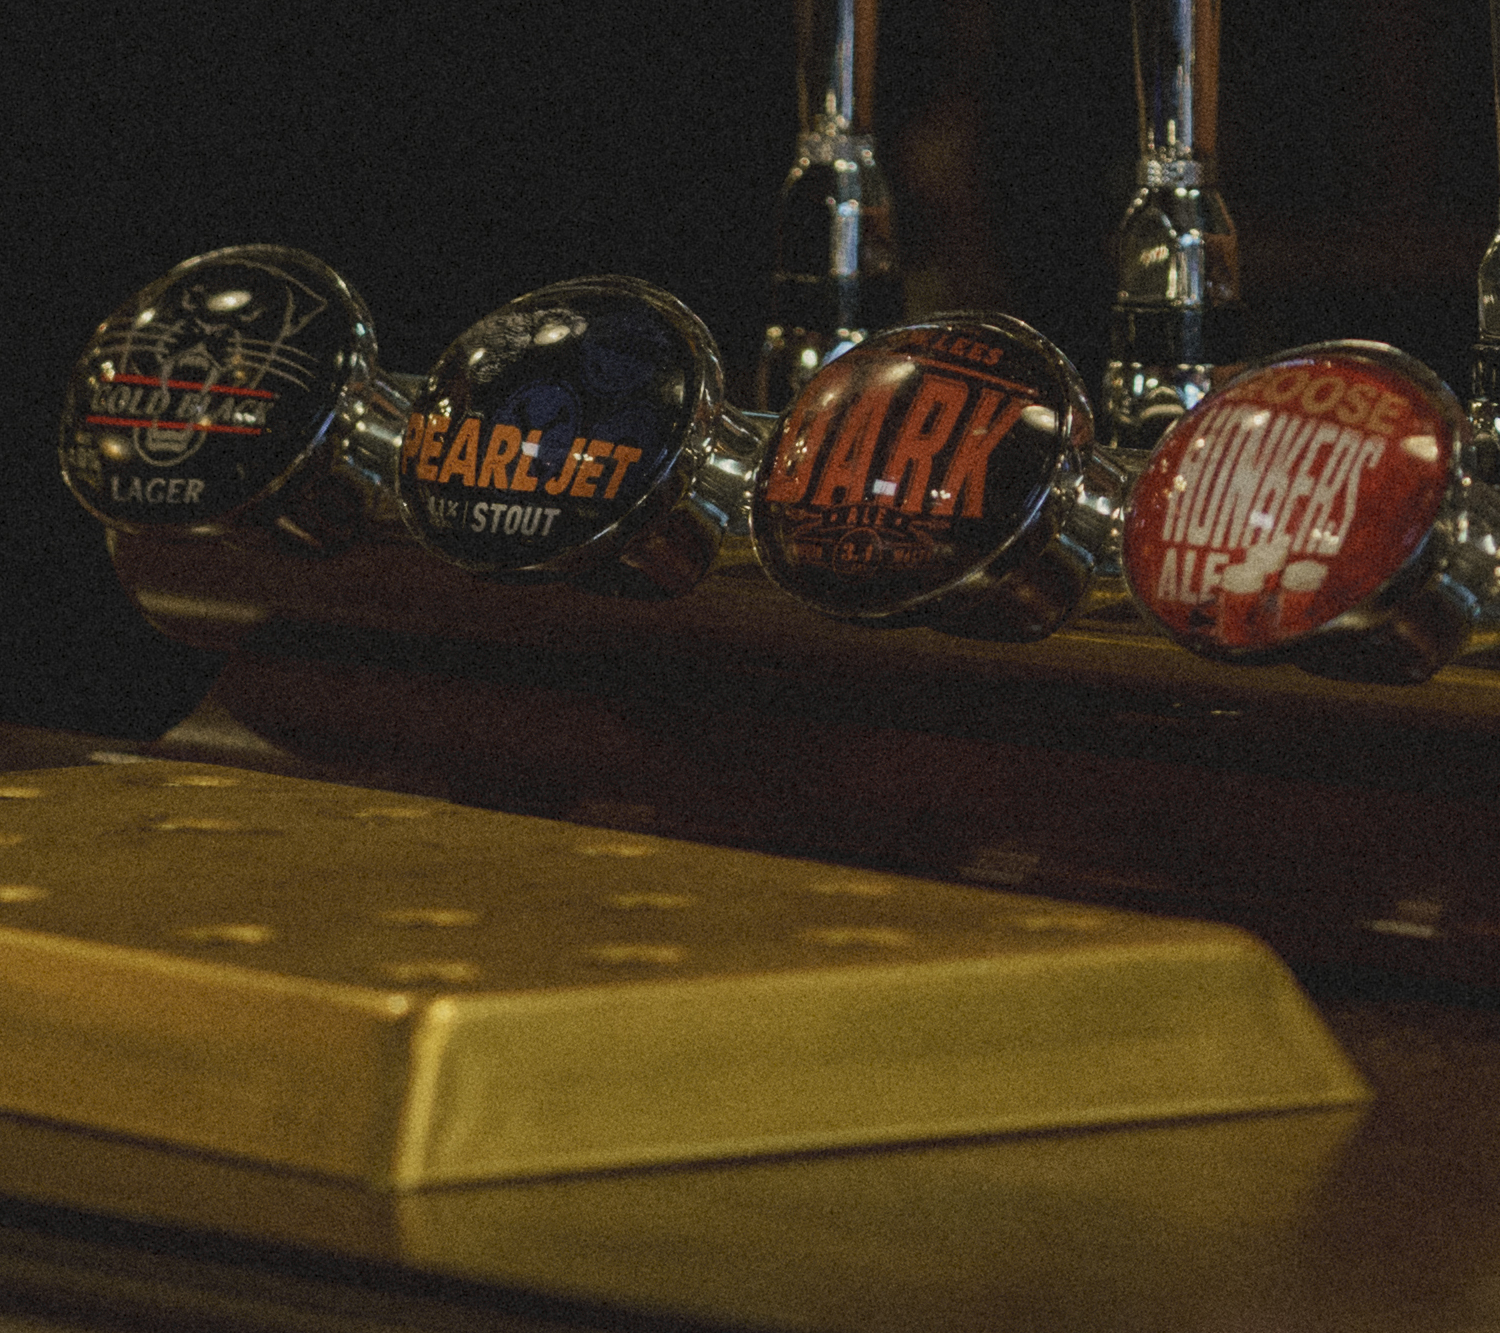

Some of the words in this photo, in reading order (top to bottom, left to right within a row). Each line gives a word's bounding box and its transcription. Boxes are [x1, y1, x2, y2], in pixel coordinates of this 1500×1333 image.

[401, 413, 543, 493] PEARL
[544, 437, 643, 500] JET
[765, 361, 1025, 520] DARK
[110, 474, 206, 505] LAGER
[470, 500, 563, 537] STOUT
[846, 505, 888, 527] ALE
[1157, 546, 1231, 605] ALE
